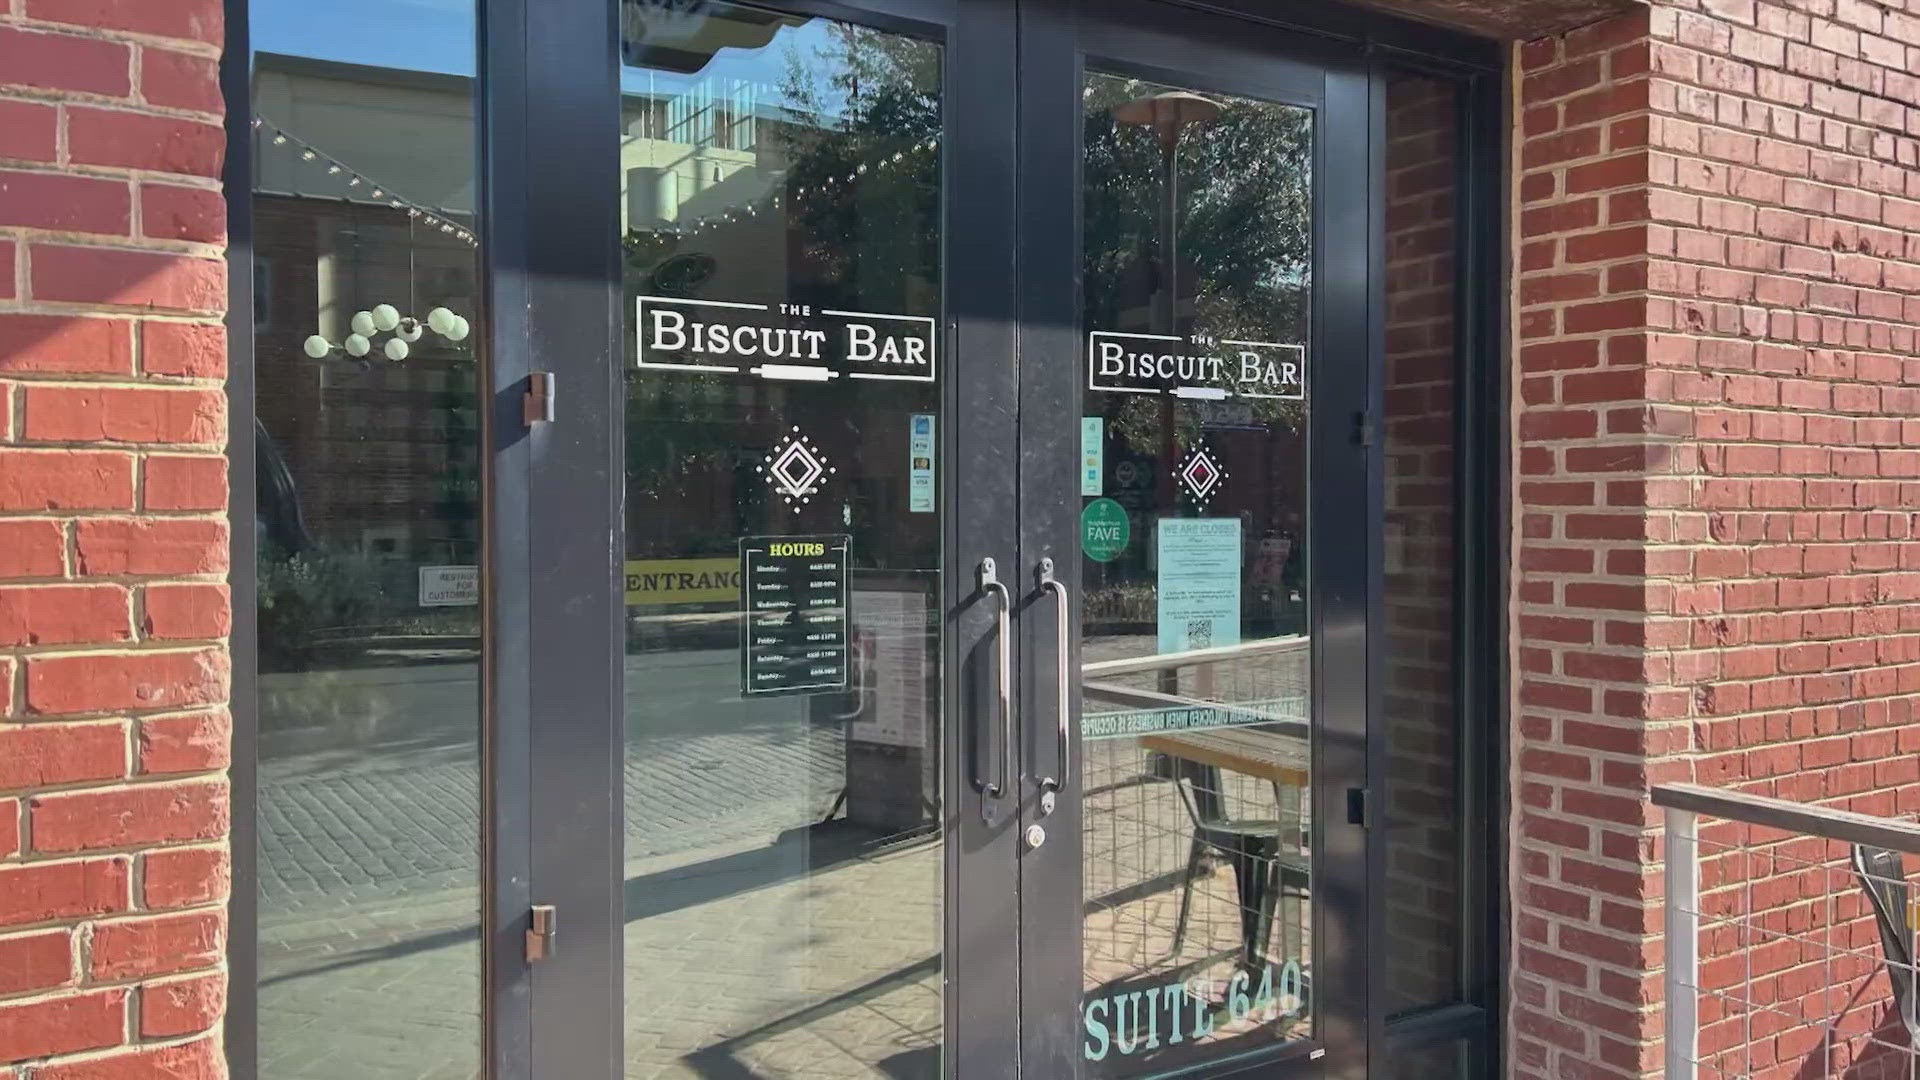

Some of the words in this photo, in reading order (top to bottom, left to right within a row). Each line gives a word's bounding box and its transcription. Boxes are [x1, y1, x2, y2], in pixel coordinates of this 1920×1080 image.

[779, 303, 811, 317] THE
[650, 309, 826, 359] BISCUIT
[846, 323, 926, 365] BAR
[1190, 334, 1213, 345] THE
[1099, 341, 1224, 381] BISCUIT
[1239, 351, 1298, 385] BAR
[1087, 527, 1121, 541] FAVE
[1181, 524, 1198, 534] ARE
[1201, 523, 1236, 534] CLOSED
[769, 543, 825, 557] HOURS
[1084, 982, 1214, 1062] SUITE
[1229, 957, 1302, 1027] 640
